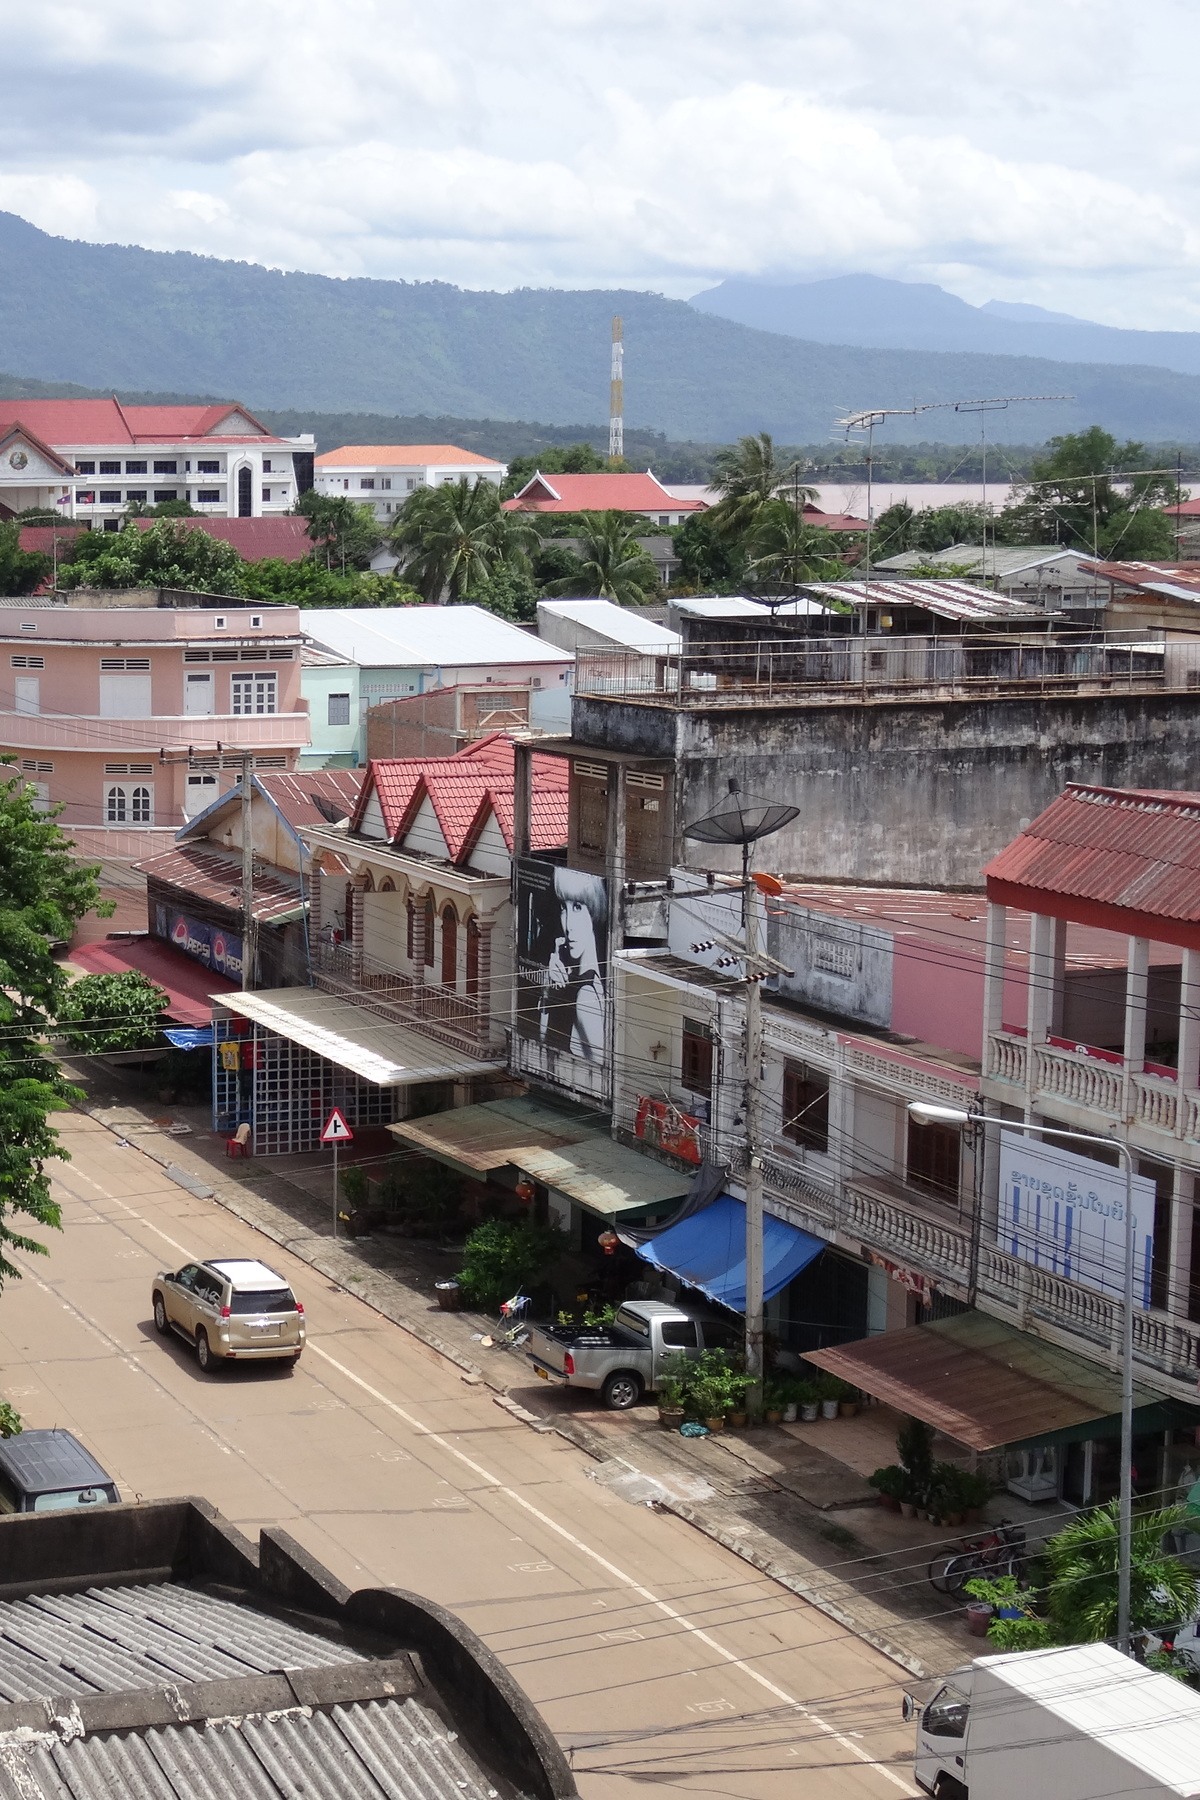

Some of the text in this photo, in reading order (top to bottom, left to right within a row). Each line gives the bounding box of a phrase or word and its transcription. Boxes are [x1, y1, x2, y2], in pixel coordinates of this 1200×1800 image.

[187, 937, 211, 959] PEPSI
[514, 1560, 555, 1573] 19
[694, 1697, 736, 1713] 15
